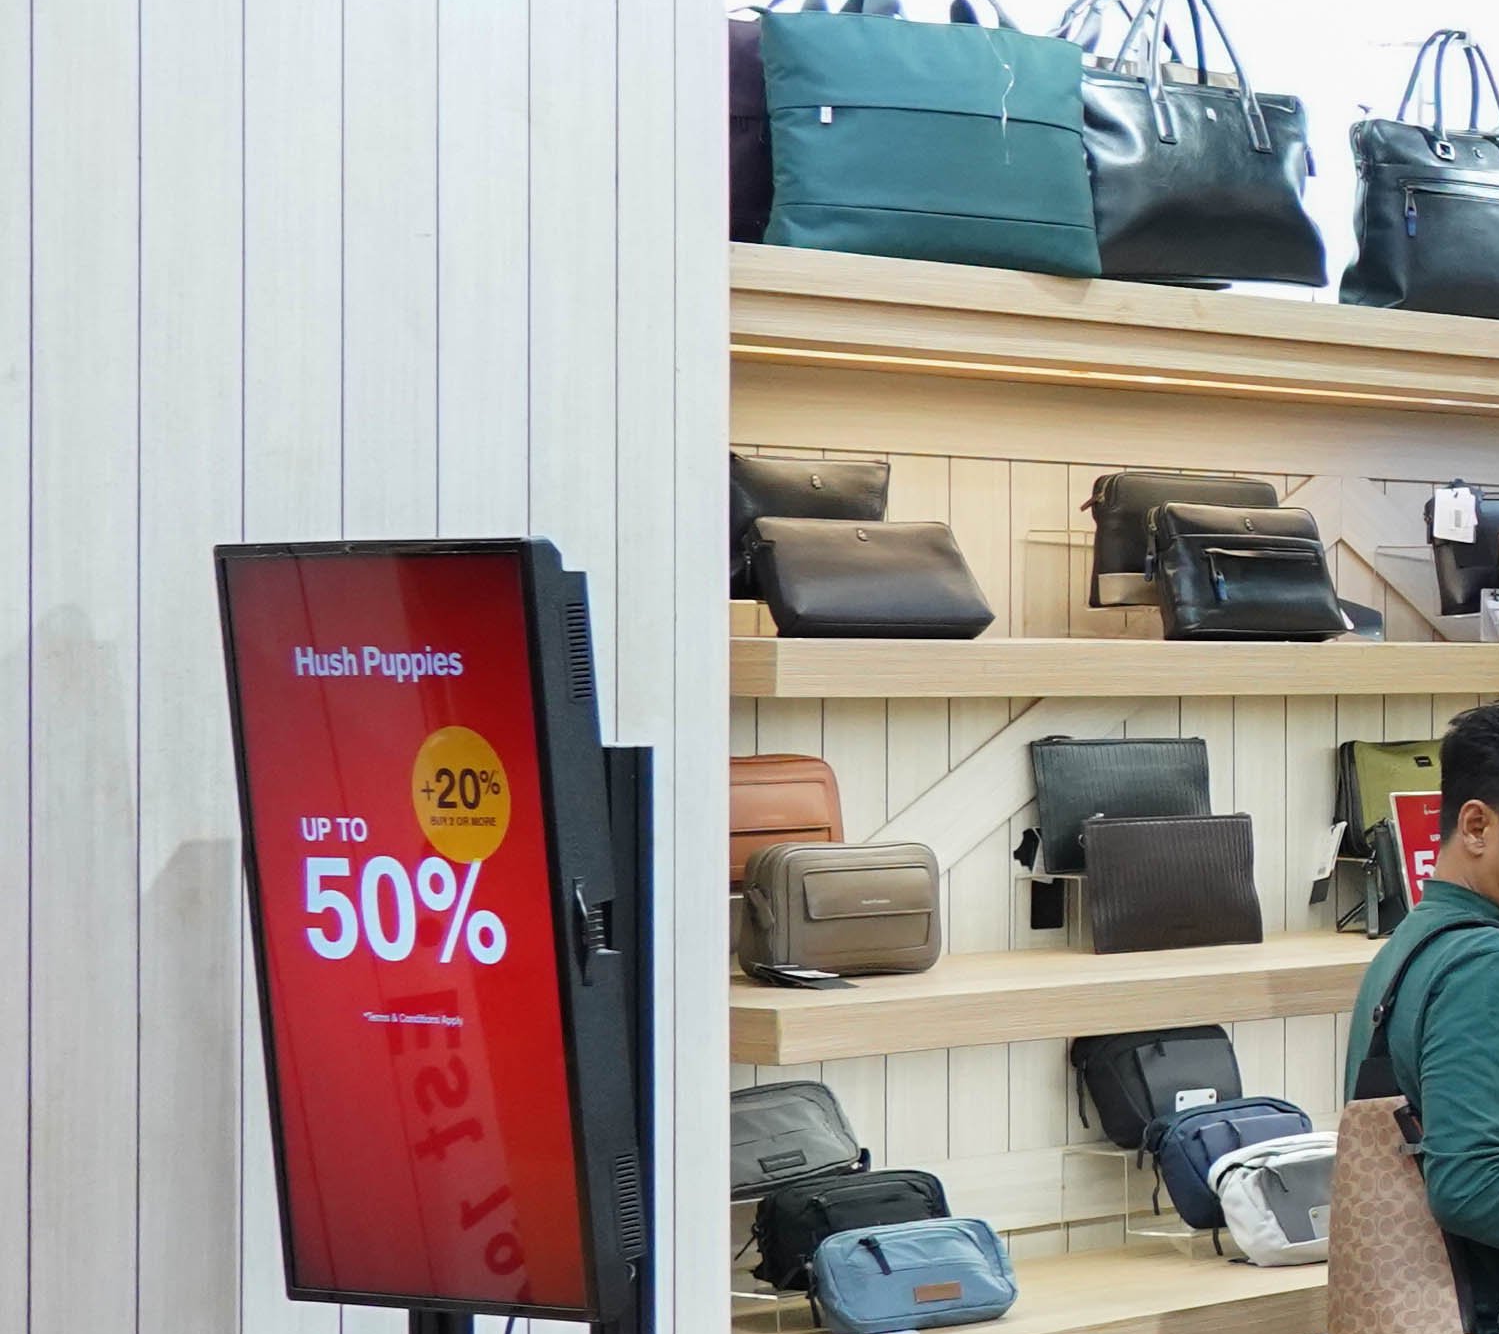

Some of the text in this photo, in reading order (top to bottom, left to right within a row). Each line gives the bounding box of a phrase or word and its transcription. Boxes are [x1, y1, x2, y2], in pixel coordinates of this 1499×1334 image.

[294, 645, 465, 682] Hush Puppies
[421, 767, 501, 810] +20%
[300, 817, 368, 842] UP TO
[430, 816, 449, 826] BUY
[457, 817, 470, 826] OR
[471, 817, 497, 827] MORE
[304, 855, 508, 965] 50%
